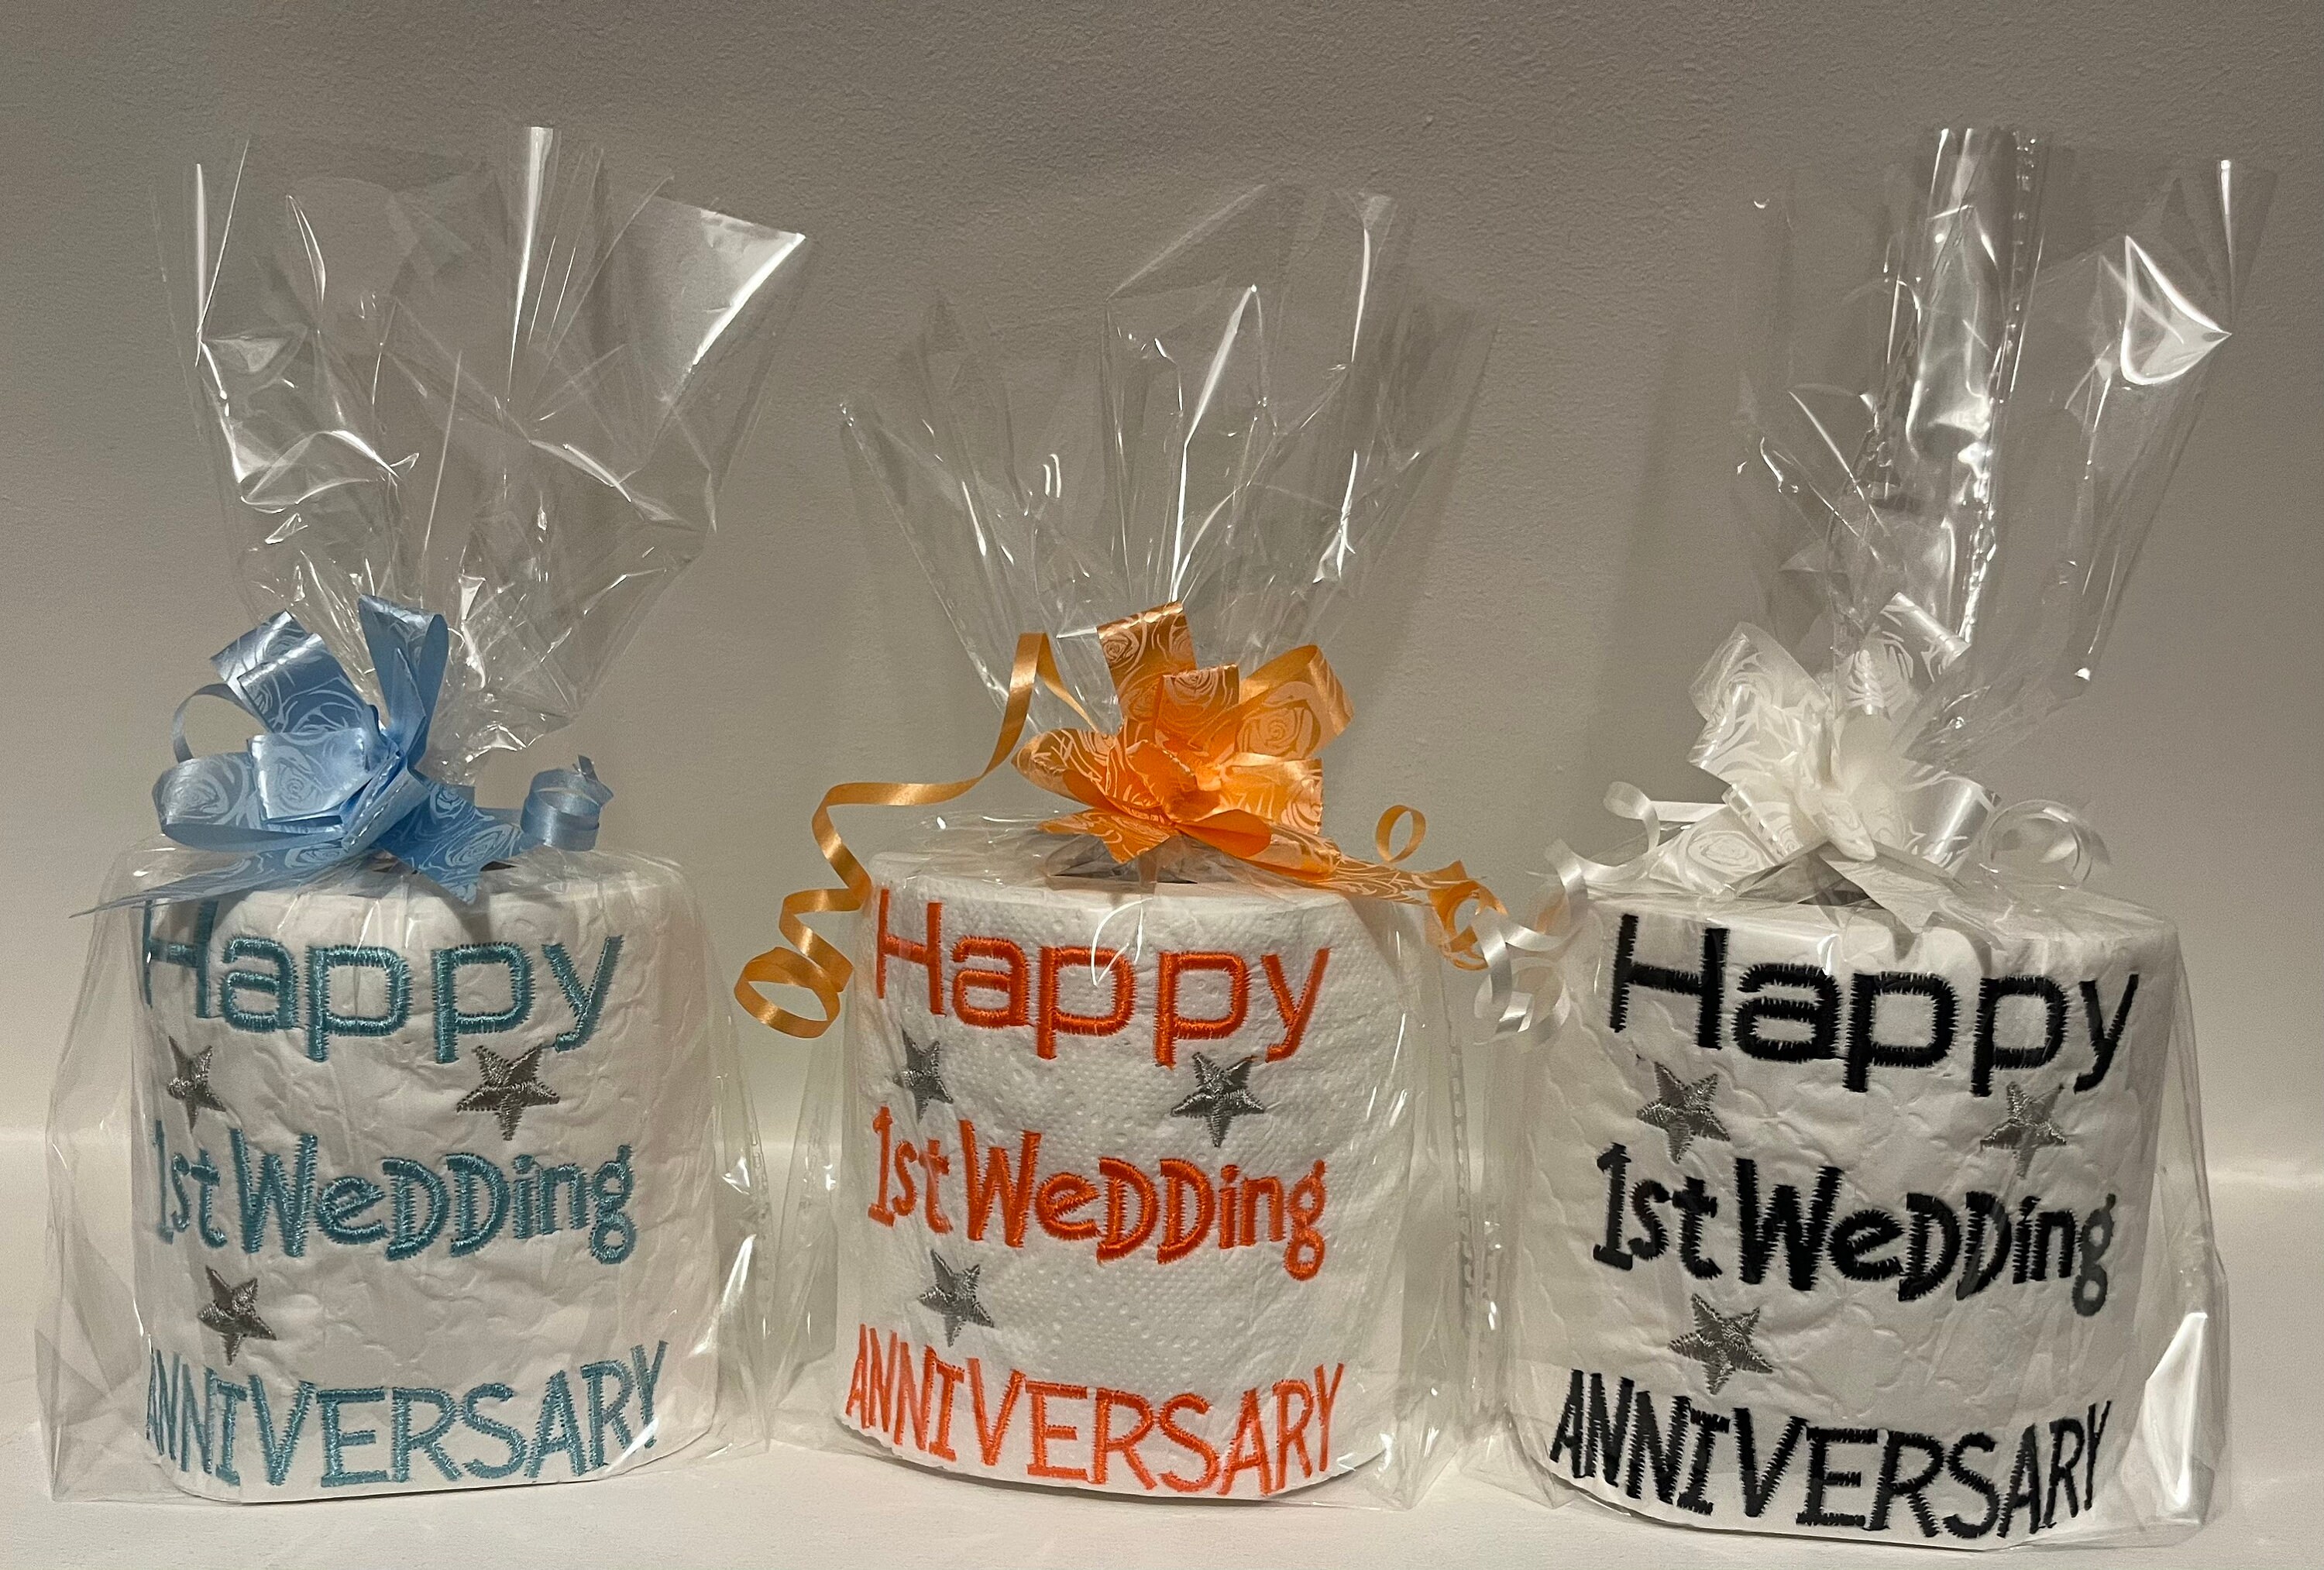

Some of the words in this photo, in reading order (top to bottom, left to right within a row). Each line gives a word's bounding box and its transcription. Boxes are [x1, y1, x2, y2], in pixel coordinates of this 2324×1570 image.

[142, 898, 624, 1064] Happy
[875, 888, 1330, 1069] Happy
[1609, 913, 2140, 1098] Happy
[153, 1119, 227, 1249] 1st
[868, 1106, 953, 1235] 1st
[1593, 1142, 1723, 1281] 1st
[845, 1324, 1344, 1496] ANNIVERSARY
[1549, 1369, 2113, 1540] ANNIVERSARY
